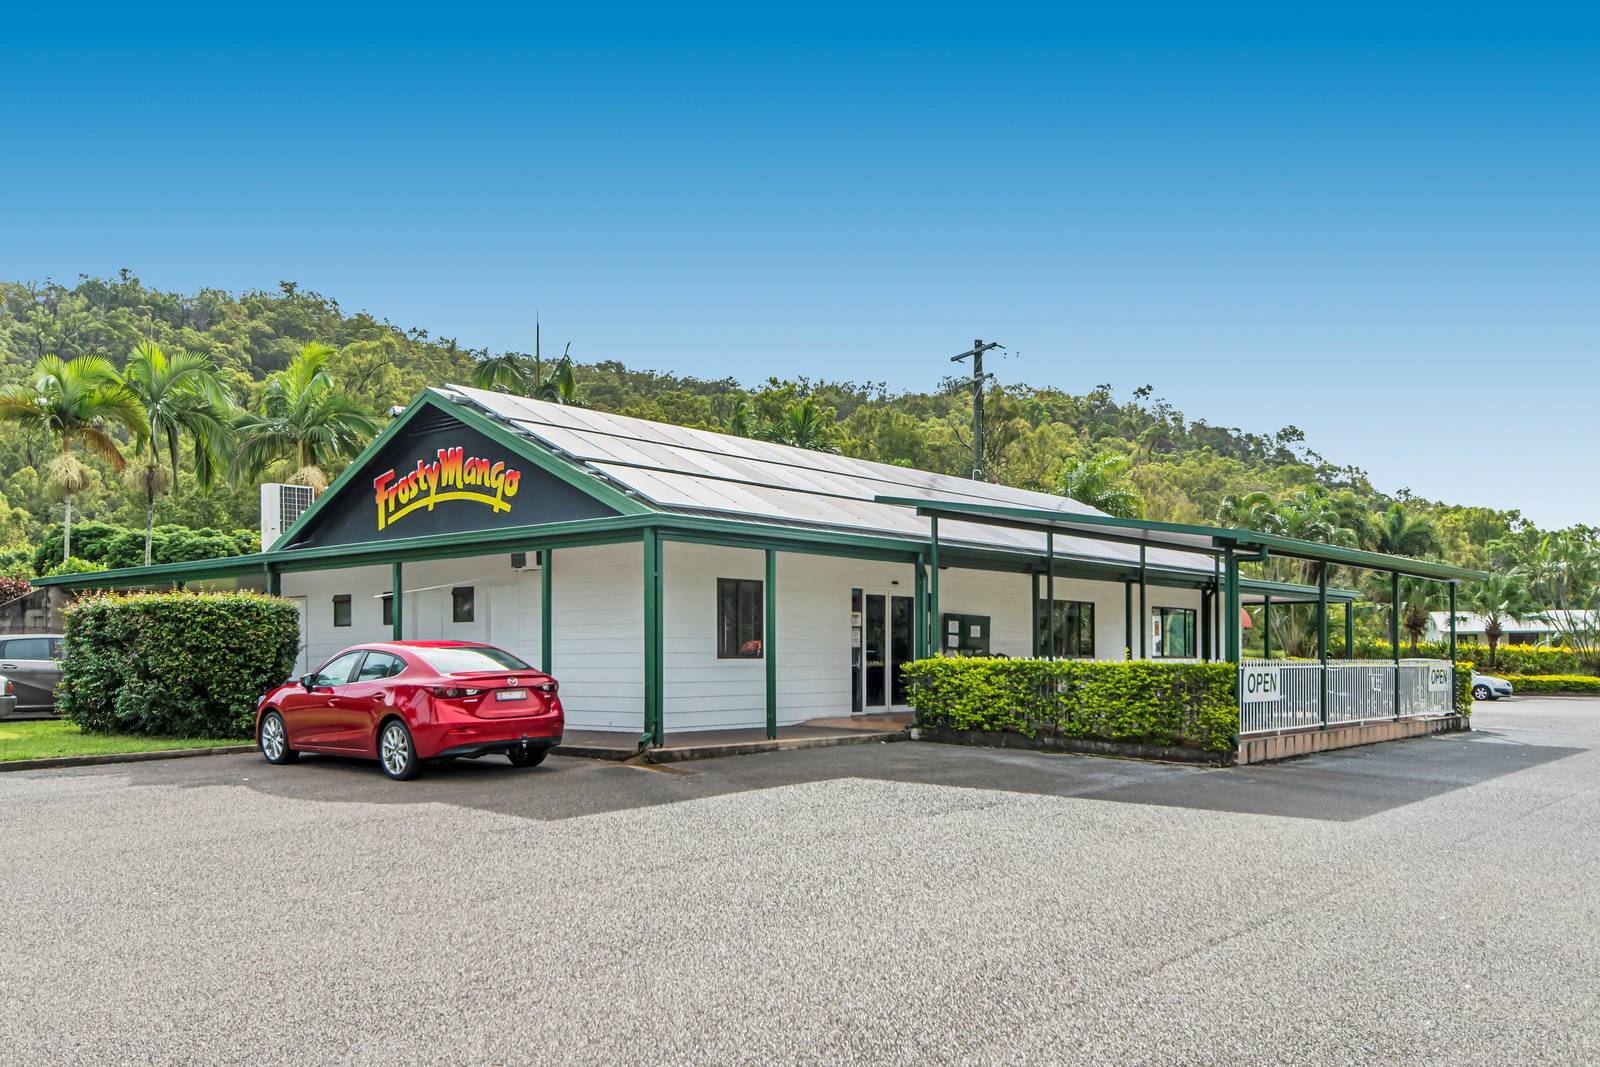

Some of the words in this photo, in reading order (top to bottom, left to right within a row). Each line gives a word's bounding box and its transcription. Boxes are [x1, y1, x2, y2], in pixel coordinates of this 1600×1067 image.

[374, 459, 441, 531] Frosty
[437, 446, 521, 513] Mango
[1247, 672, 1277, 694] OPEN
[1431, 668, 1448, 685] OPEN
